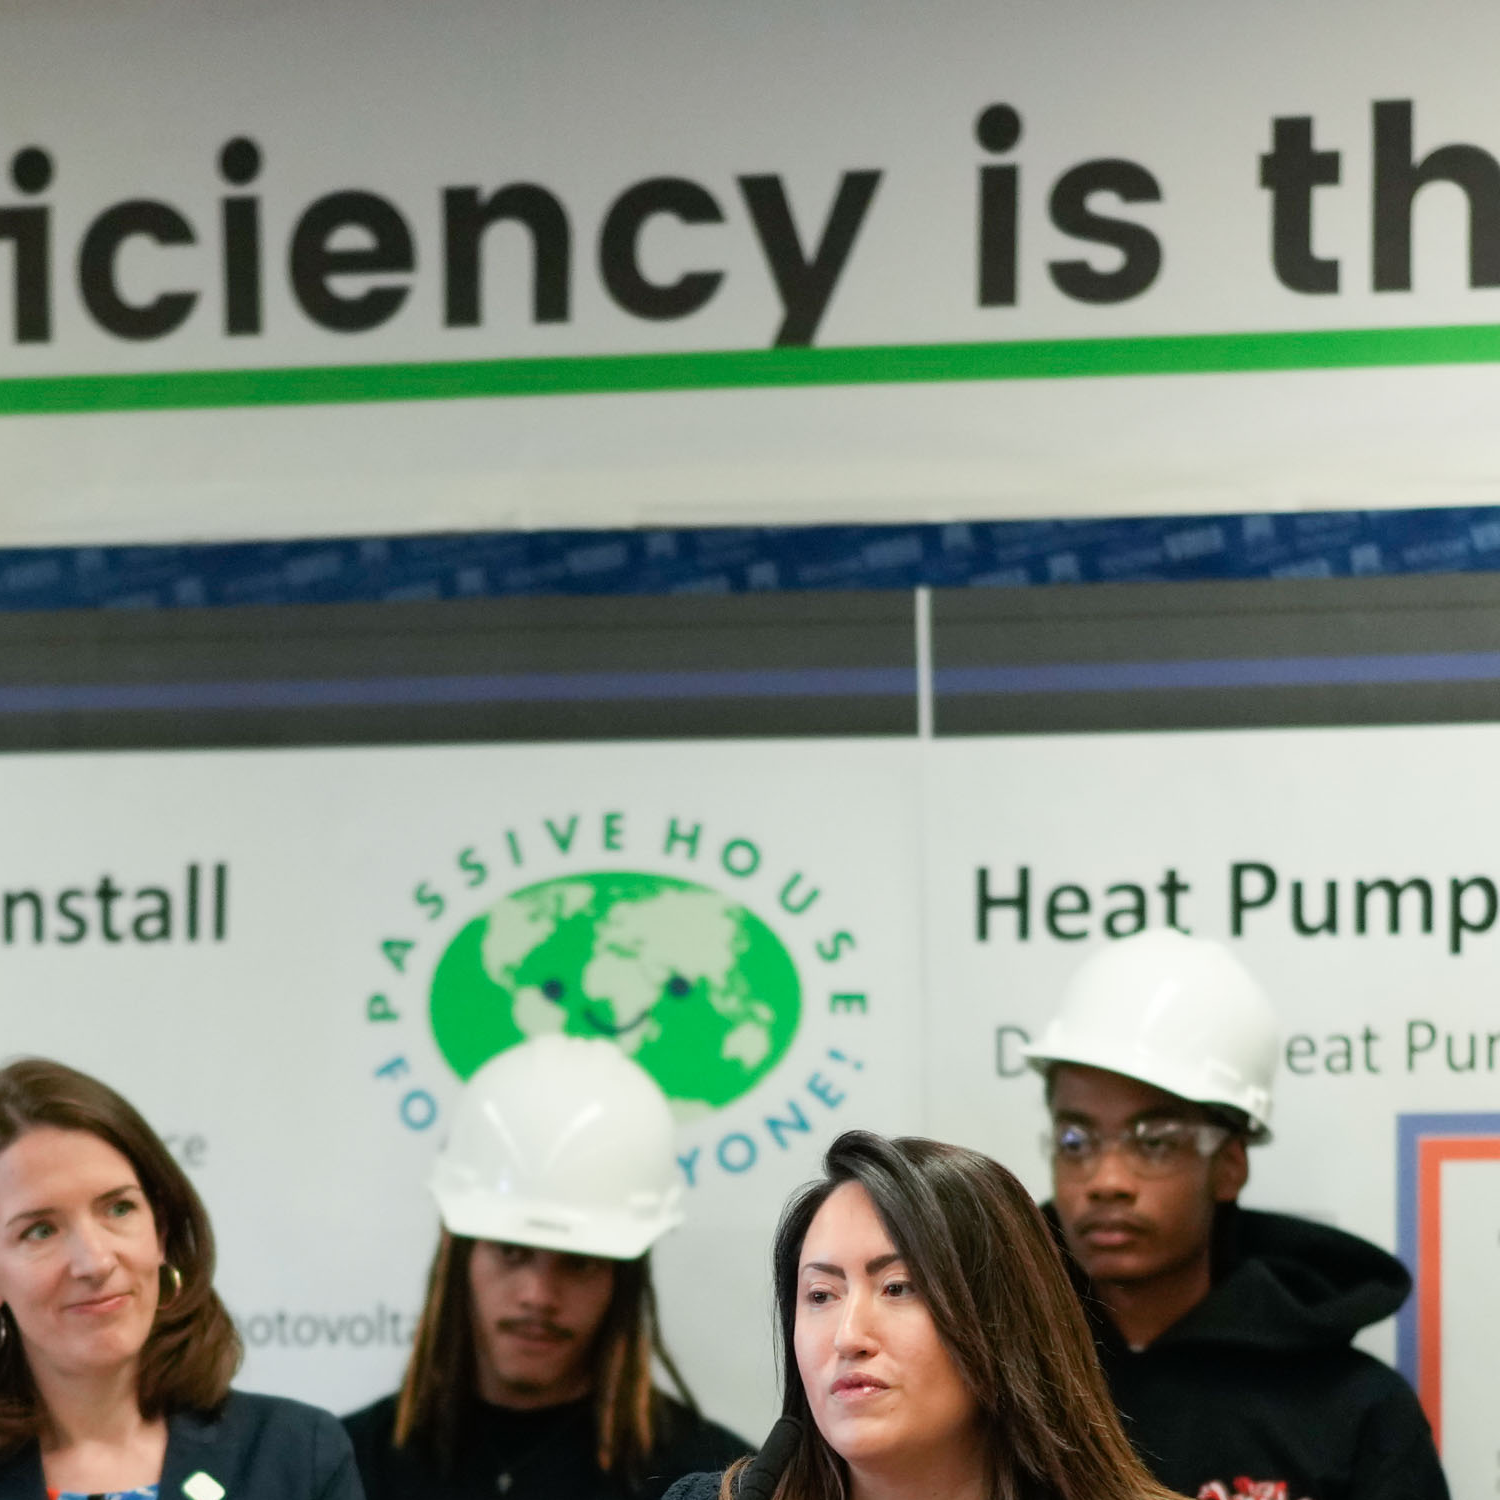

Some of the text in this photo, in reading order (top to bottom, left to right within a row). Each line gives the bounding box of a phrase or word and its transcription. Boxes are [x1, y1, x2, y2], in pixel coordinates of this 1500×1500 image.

[976, 102, 1164, 308] is
[367, 811, 869, 1024] PASSIVE HOUSE
[973, 864, 1194, 944] Heat
[1228, 859, 1500, 955] Pump
[675, 1048, 866, 1188] YONE!
[1284, 1023, 1381, 1076] eat
